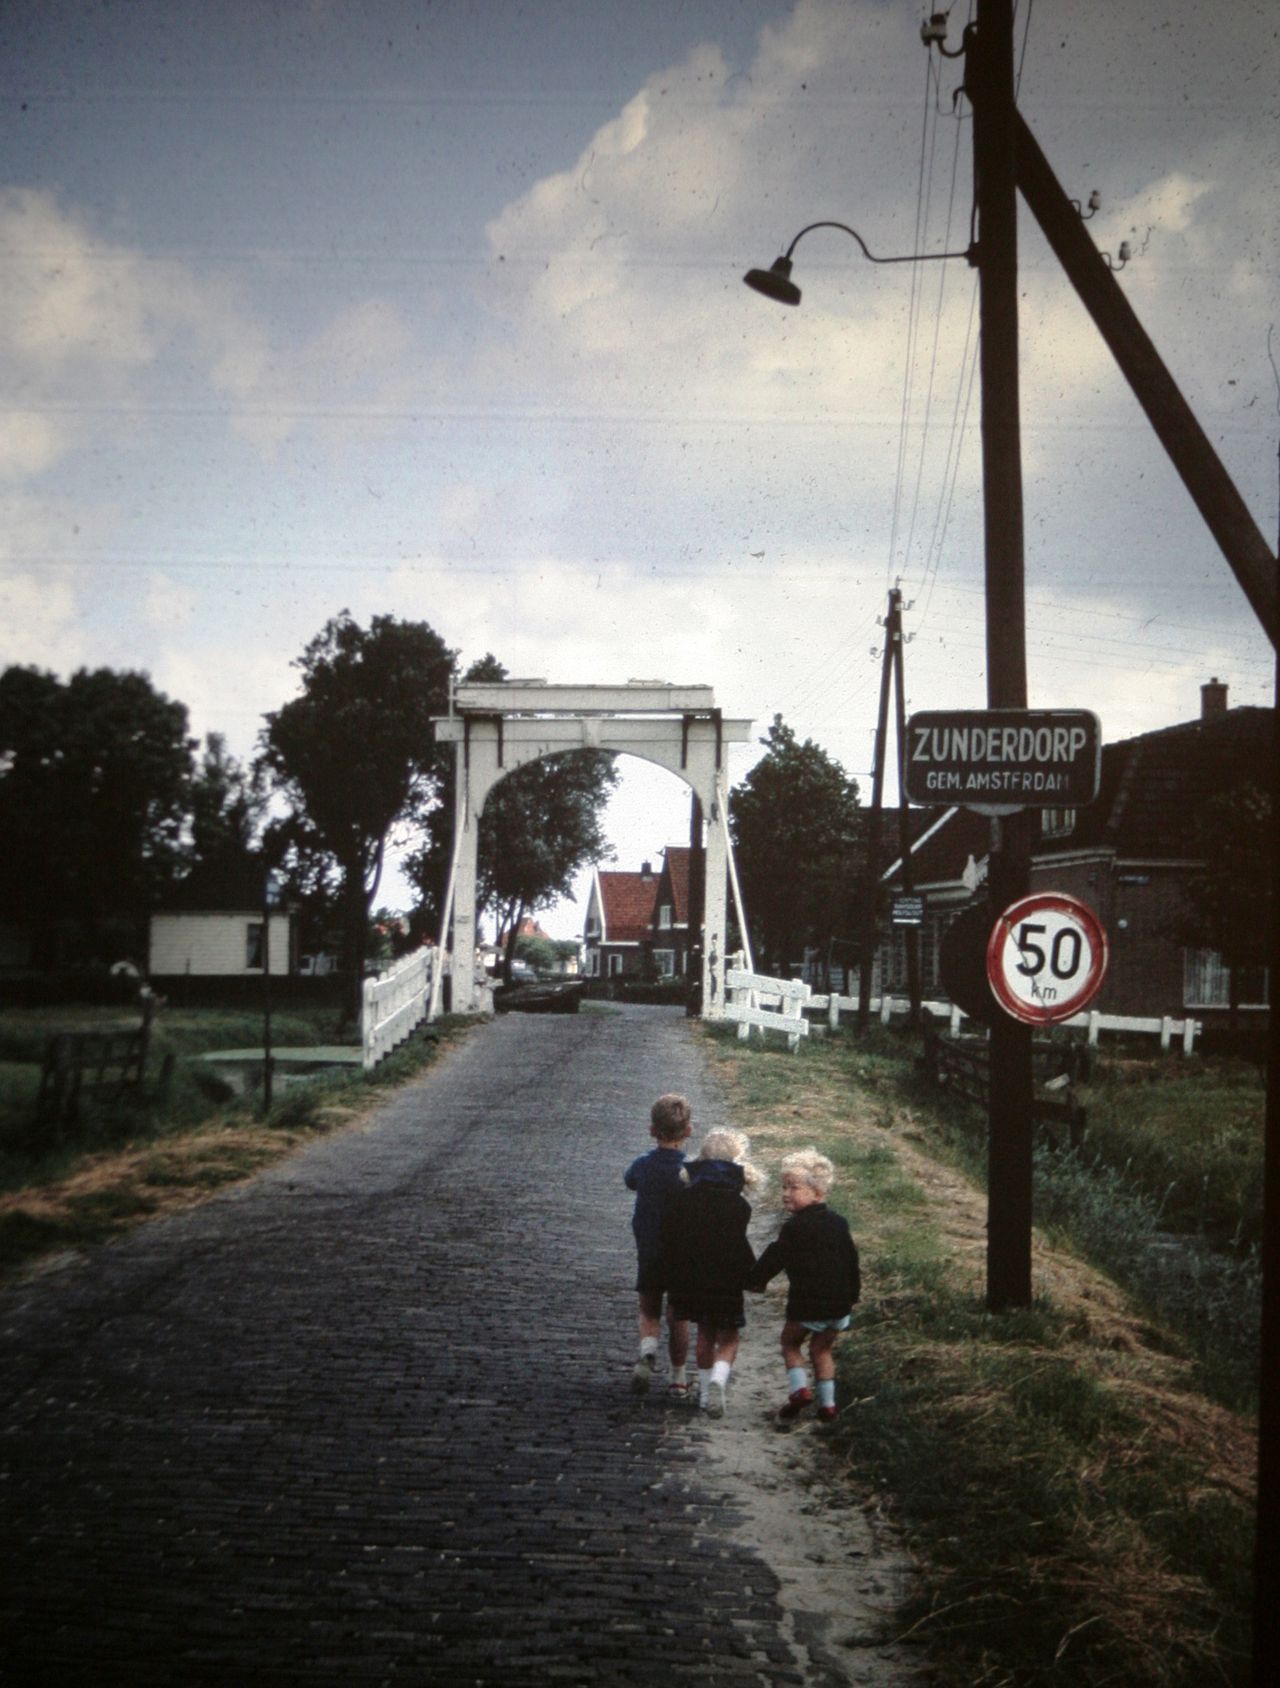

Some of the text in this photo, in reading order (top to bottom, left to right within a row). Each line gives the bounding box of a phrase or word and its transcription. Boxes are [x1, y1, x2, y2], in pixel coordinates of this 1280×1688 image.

[912, 727, 1087, 762] ZUNDERDORP
[926, 771, 963, 790] GEM.
[1015, 923, 1082, 980] 50
[1031, 981, 1057, 1000] km
